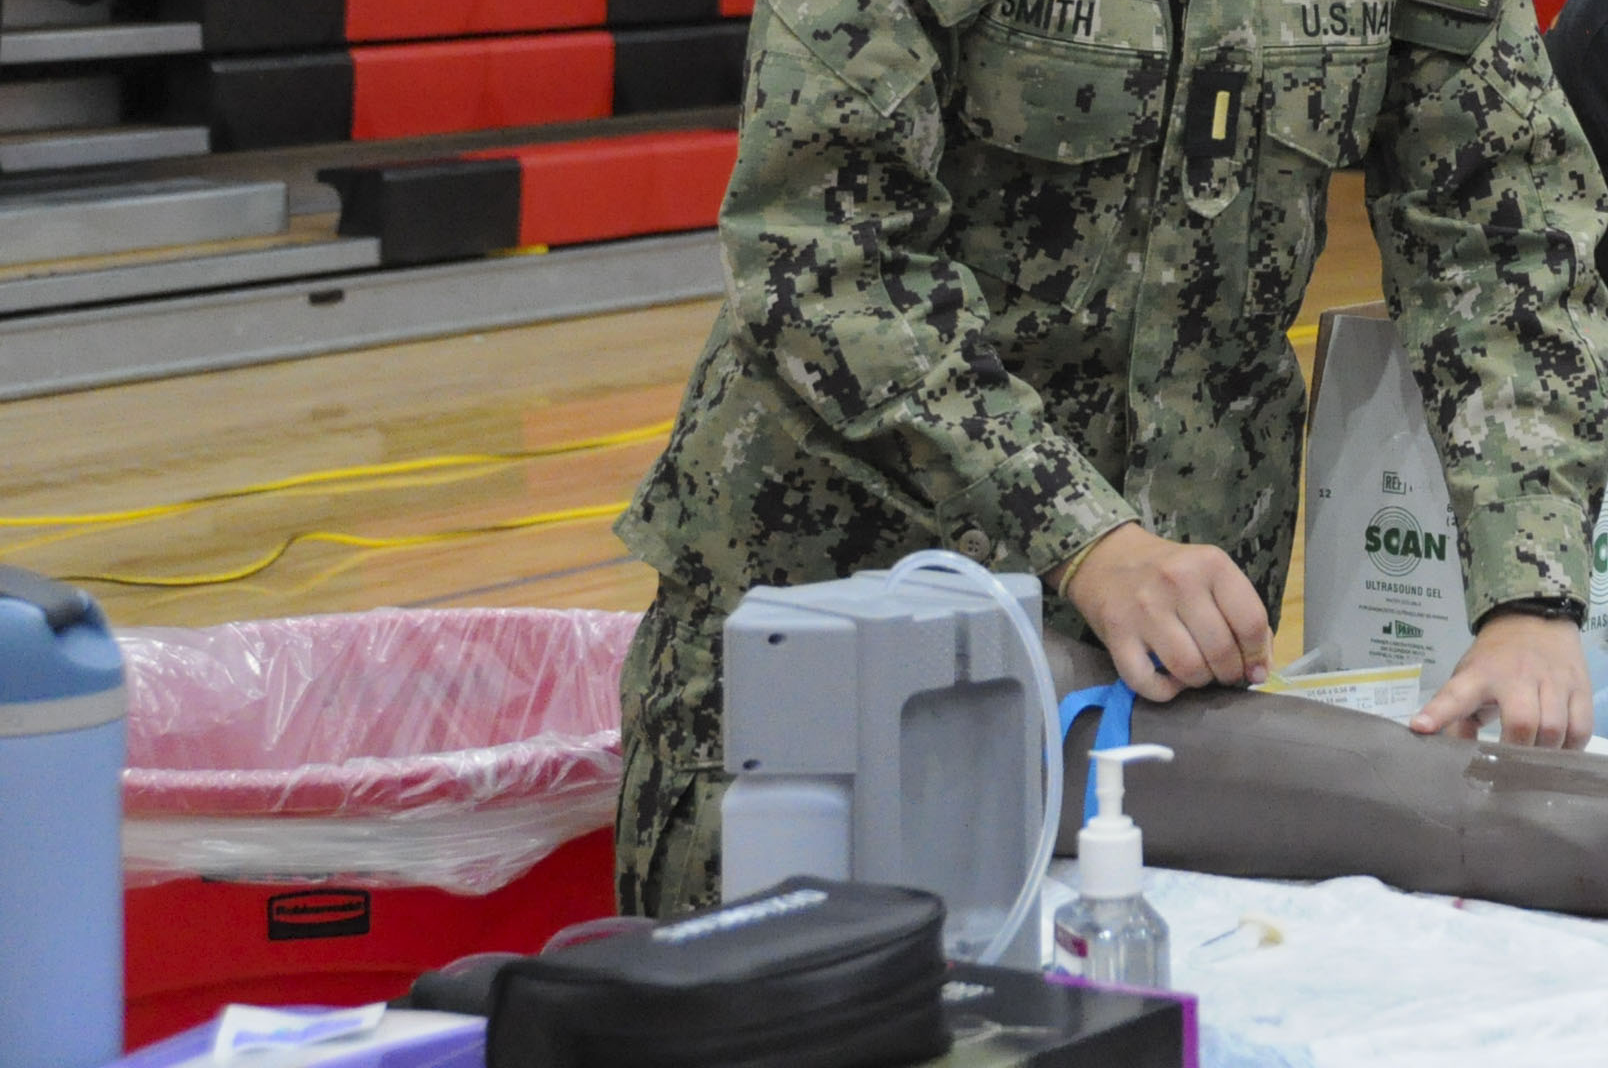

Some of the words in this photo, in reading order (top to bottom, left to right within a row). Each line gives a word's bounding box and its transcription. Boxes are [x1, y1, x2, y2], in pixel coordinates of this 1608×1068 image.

[1302, 2, 1355, 37] U.S.
[1362, 1, 1390, 36] NA
[1319, 488, 1331, 498] 12
[1364, 525, 1446, 561] SCAN
[1365, 580, 1423, 597] ULTRASOUND
[1426, 588, 1442, 599] GEL
